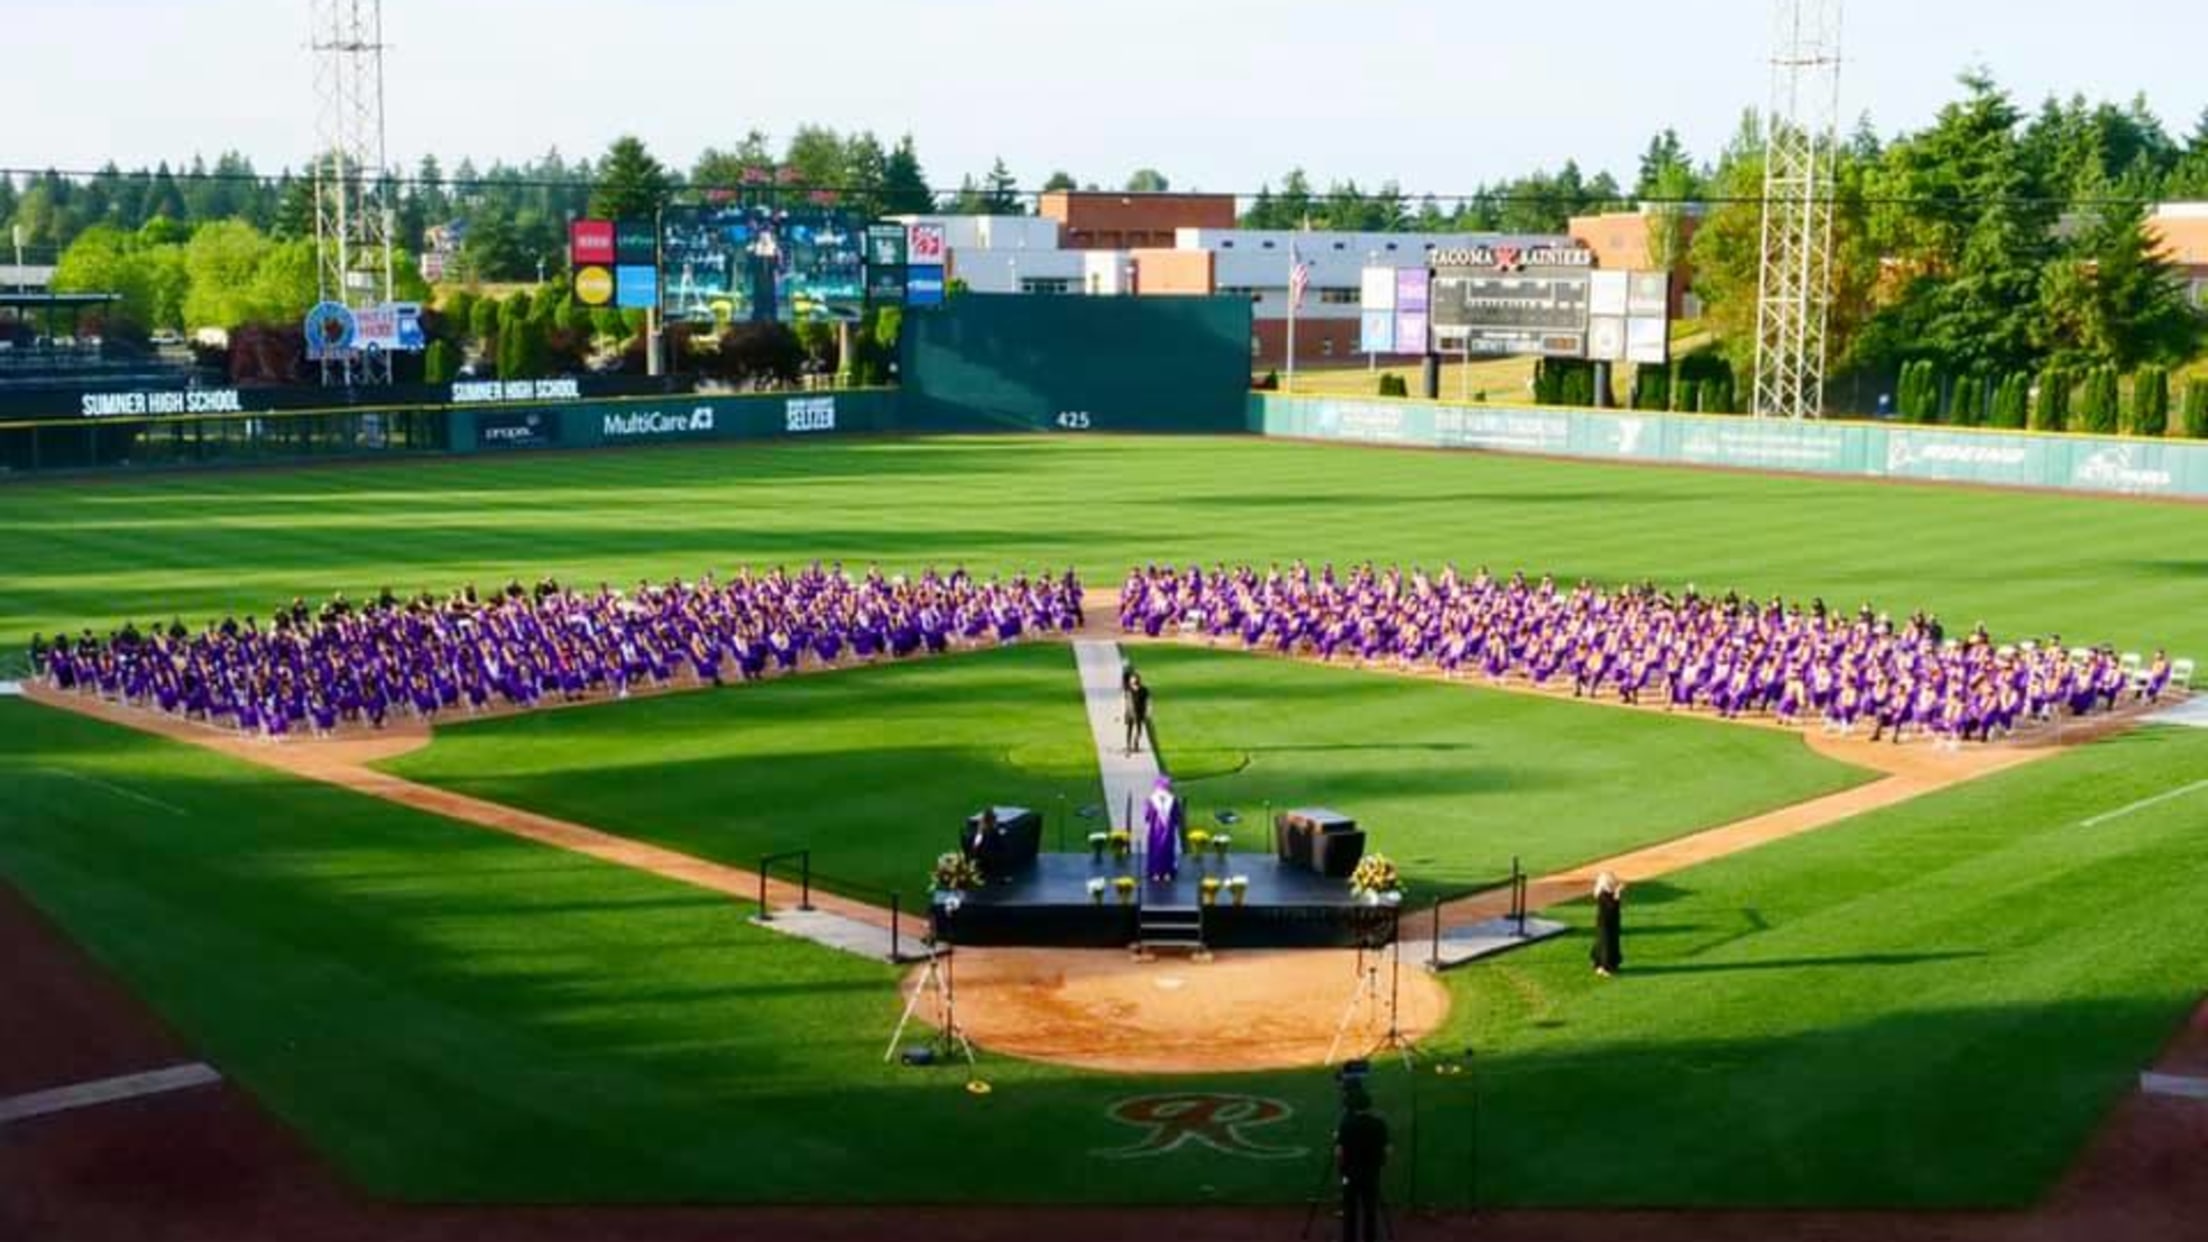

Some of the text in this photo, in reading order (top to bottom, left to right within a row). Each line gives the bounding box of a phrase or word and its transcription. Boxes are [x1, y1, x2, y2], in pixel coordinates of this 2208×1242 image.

[1431, 249, 1493, 265] TACOMA
[450, 378, 581, 402] SUMNER HIGH SCHOOL
[81, 390, 242, 416] SUMNER HIGH SCHOOL
[603, 412, 687, 435] MultiCare
[1056, 411, 1090, 429] 425
